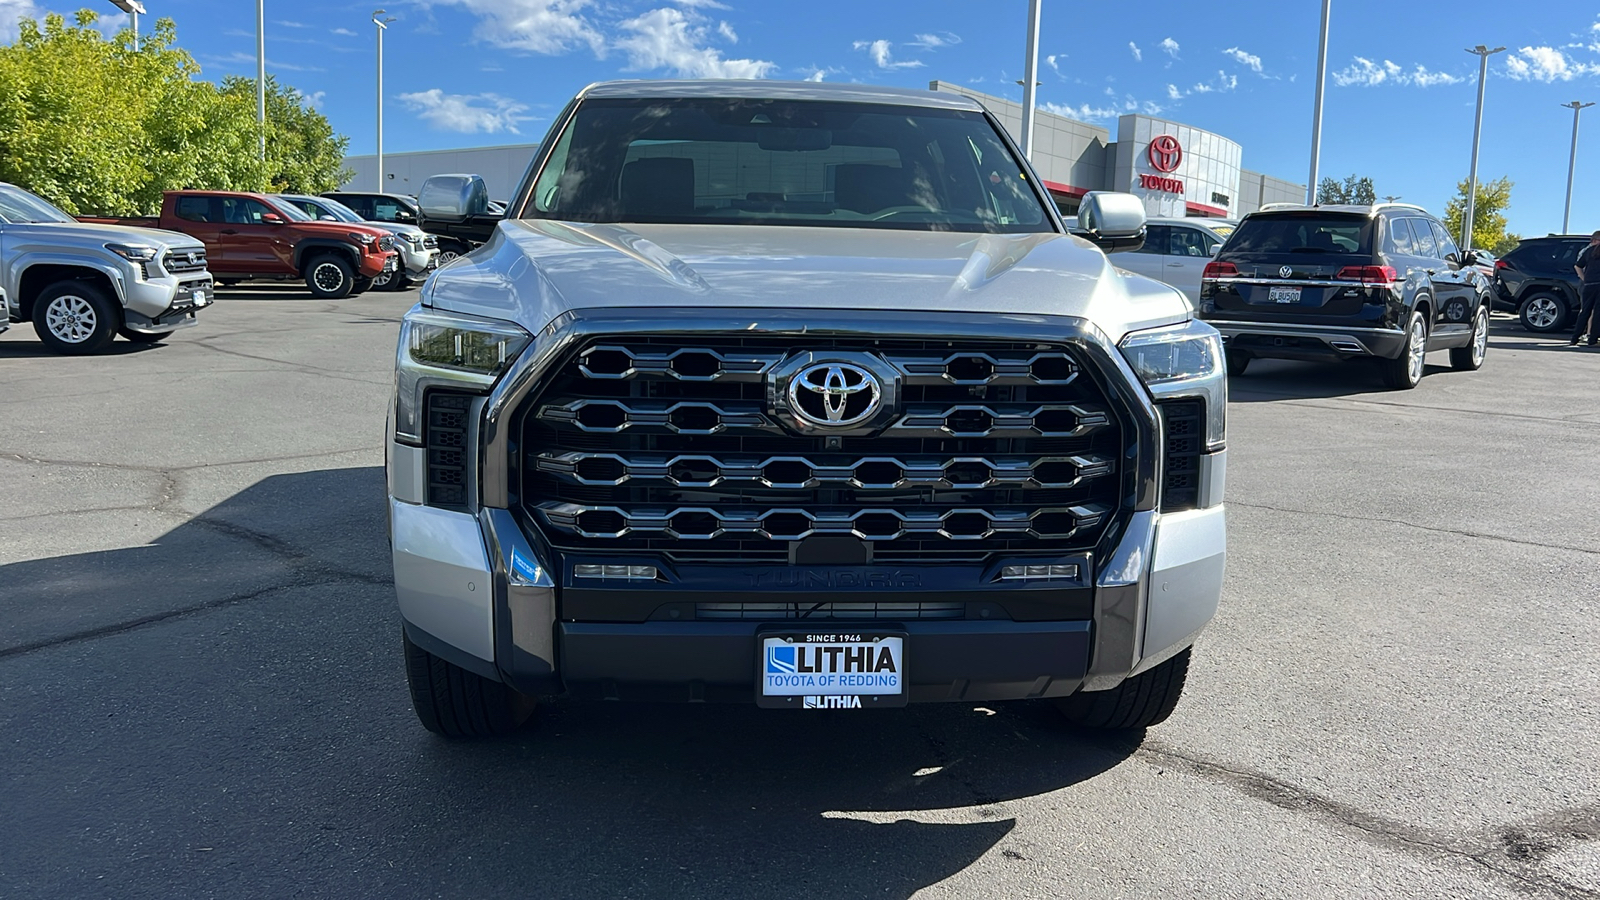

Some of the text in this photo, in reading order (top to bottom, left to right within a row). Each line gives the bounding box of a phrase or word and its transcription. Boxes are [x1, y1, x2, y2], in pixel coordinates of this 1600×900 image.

[1140, 174, 1184, 194] TOYOTA
[1269, 291, 1300, 301] 8LBU500
[744, 570, 922, 588] TUNDRA
[806, 634, 861, 642] SINCE 1946
[797, 646, 897, 673] LITHIA
[767, 675, 897, 687] TOYOTA OF REDDING
[816, 695, 862, 709] LITHIA
